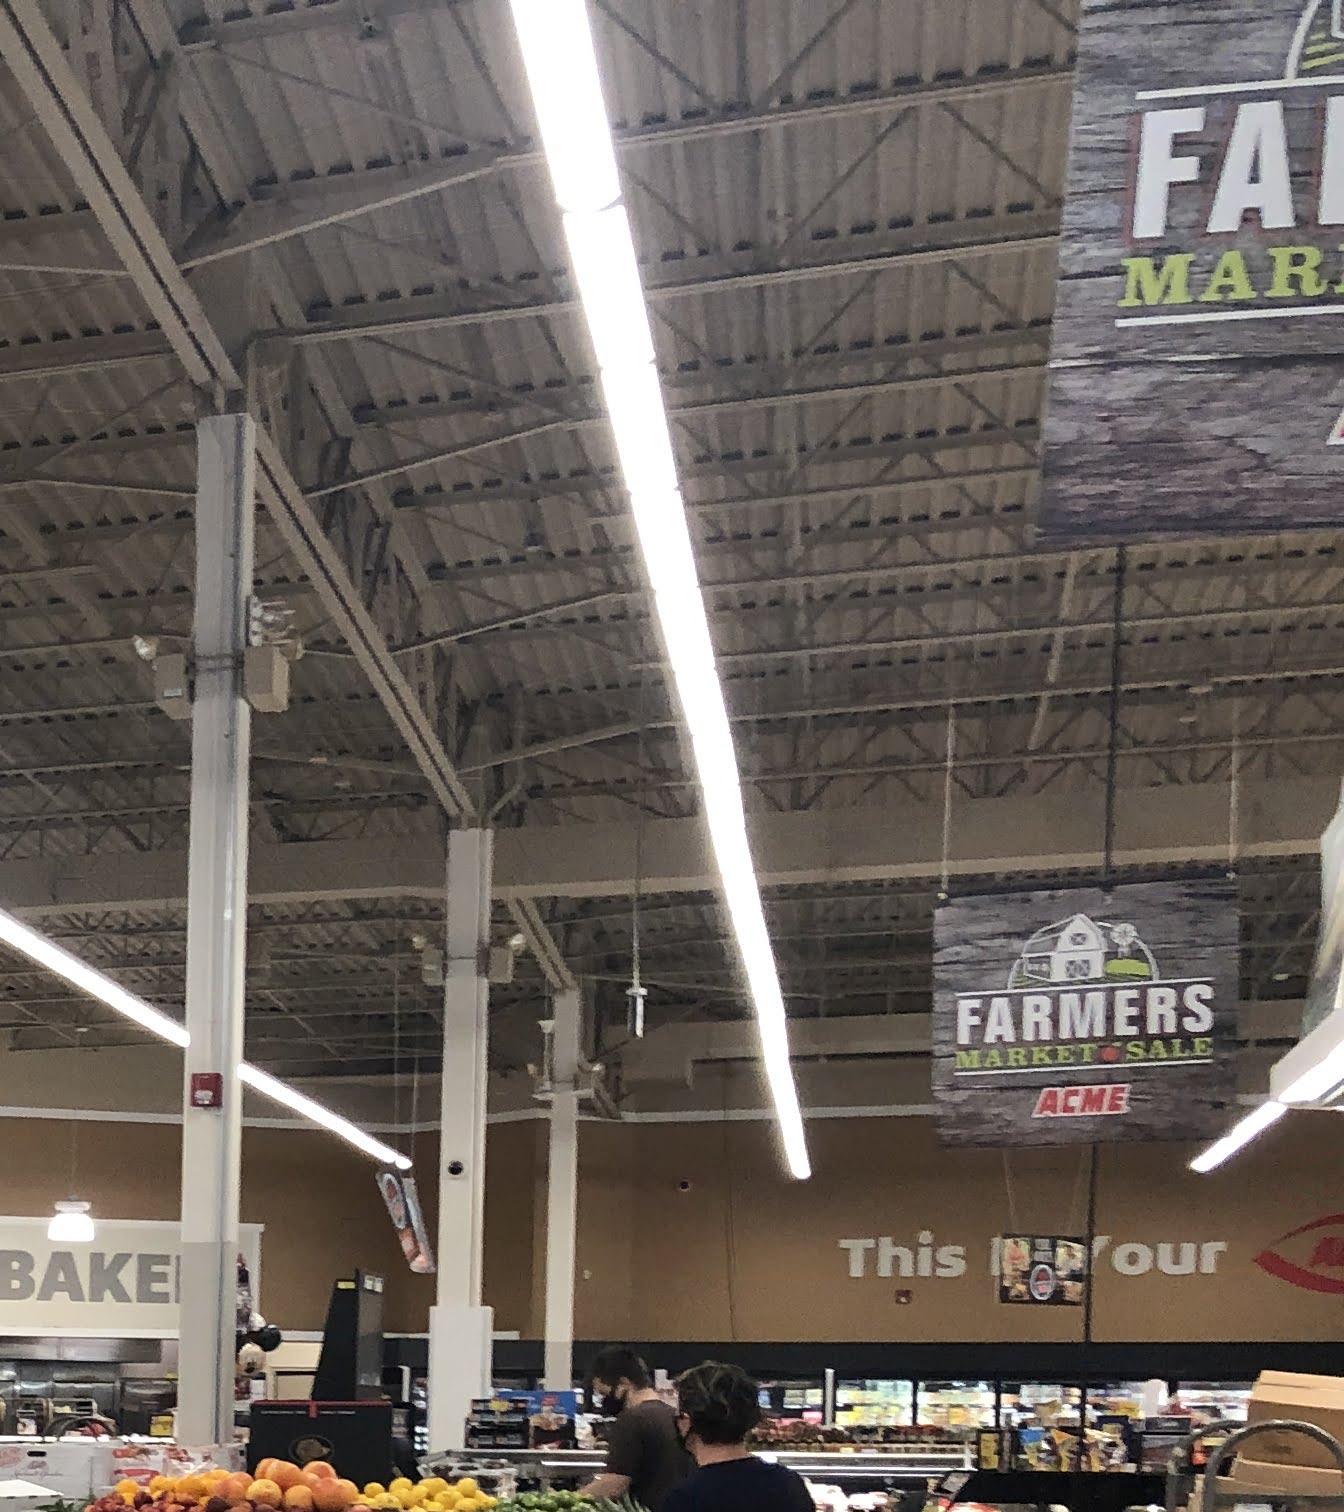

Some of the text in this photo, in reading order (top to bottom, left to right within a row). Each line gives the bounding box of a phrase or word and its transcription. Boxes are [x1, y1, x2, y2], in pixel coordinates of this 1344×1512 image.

[1117, 245, 1343, 307] MAR
[956, 984, 1215, 1045] FARMERS
[955, 1037, 1214, 1069] MARKET SALE
[1033, 1084, 1131, 1118] ACME
[839, 1230, 967, 1277] This
